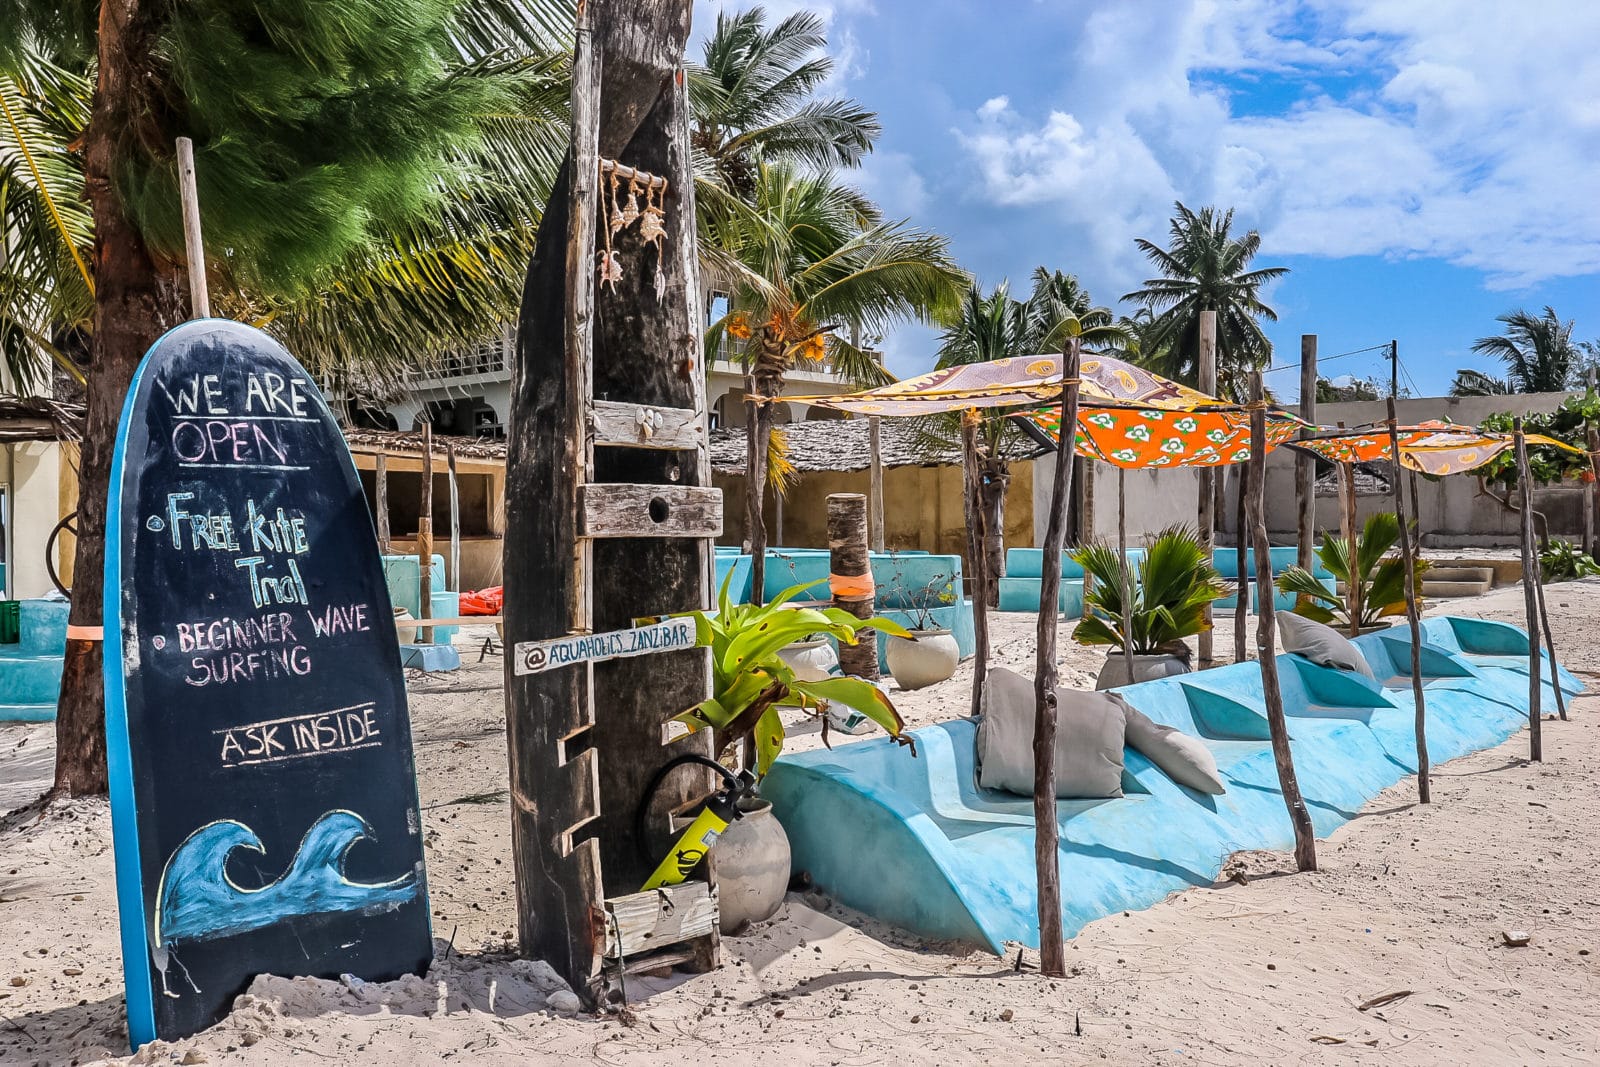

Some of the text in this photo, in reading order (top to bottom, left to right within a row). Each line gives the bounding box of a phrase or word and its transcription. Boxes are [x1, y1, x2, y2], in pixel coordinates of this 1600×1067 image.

[156, 373, 308, 417] WE ARE
[172, 421, 288, 464] OPEN
[234, 556, 308, 608] Trial
[308, 604, 370, 638] WAVE
[221, 709, 380, 761] ASK INSIDE
